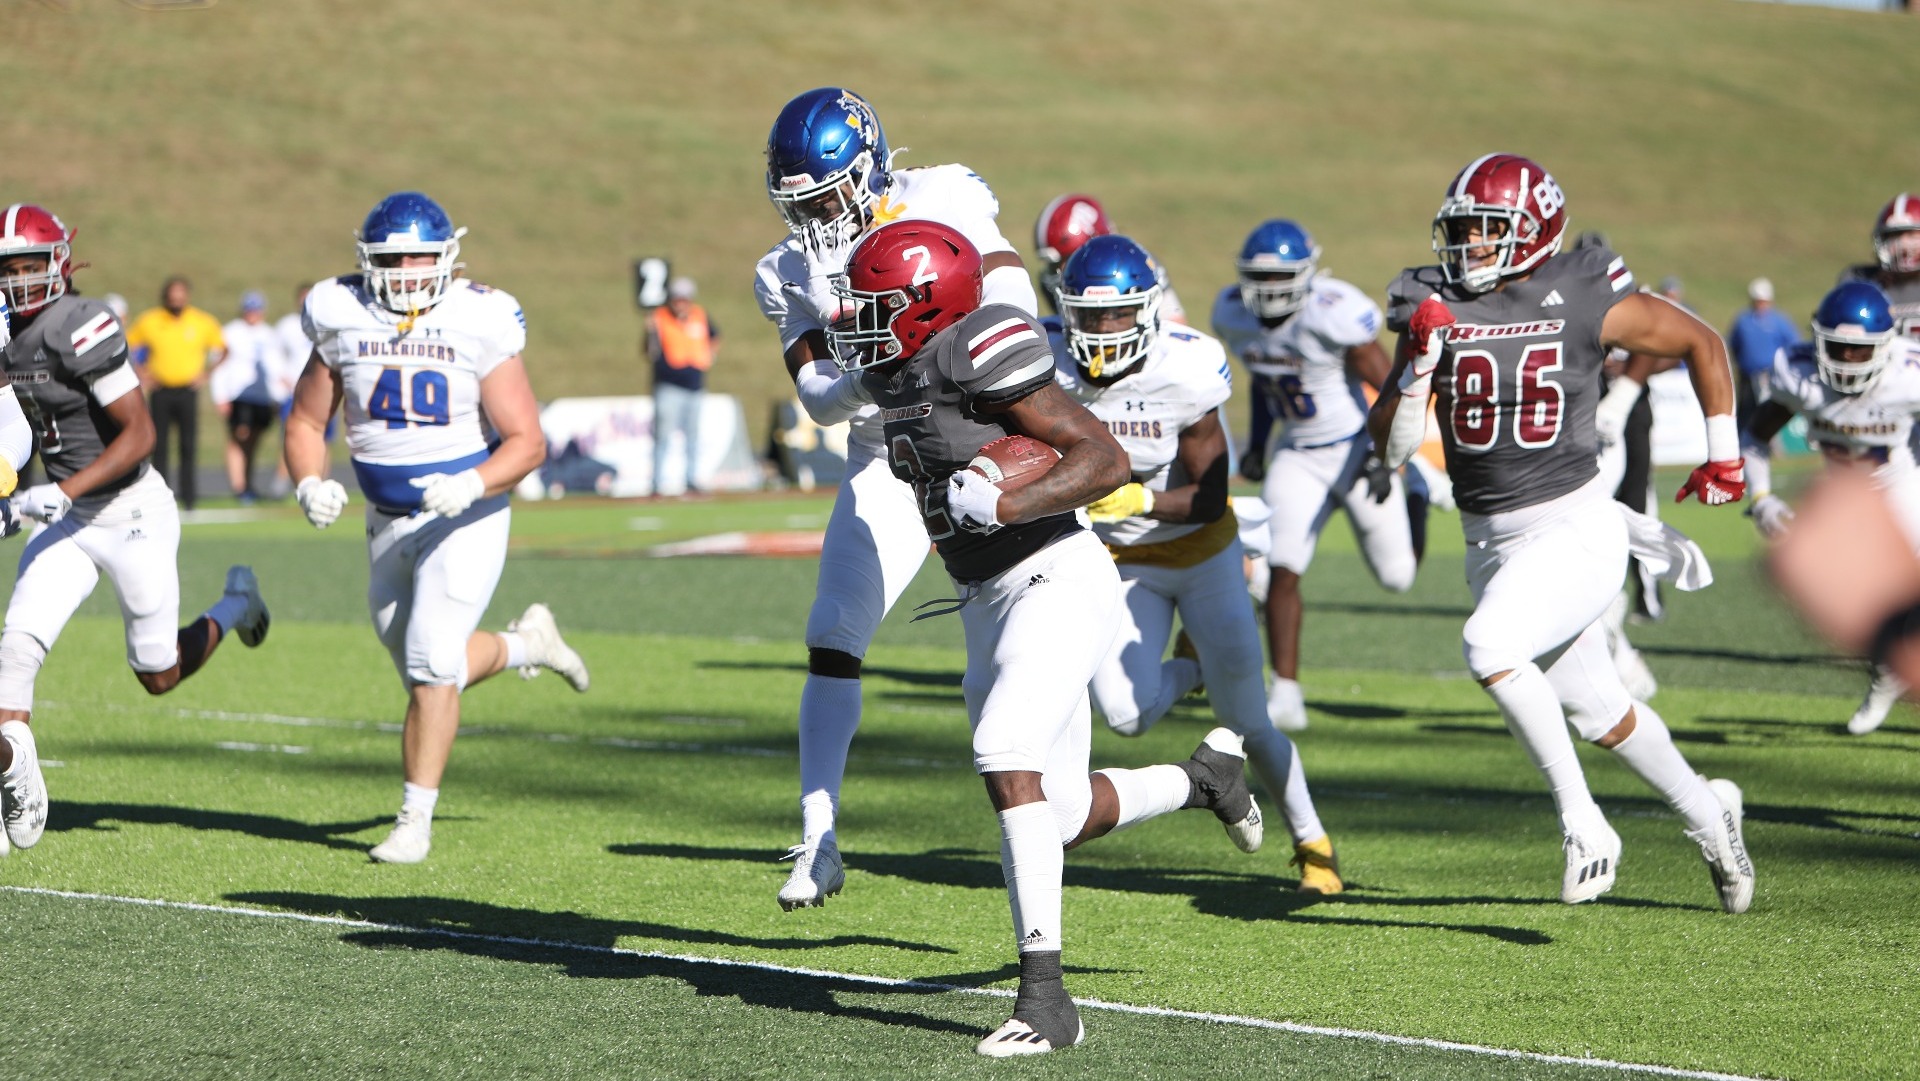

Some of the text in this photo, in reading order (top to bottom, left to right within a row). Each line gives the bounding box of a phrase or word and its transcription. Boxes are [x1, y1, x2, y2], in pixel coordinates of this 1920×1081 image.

[1532, 173, 1566, 220] 86
[639, 258, 668, 307] 2
[902, 245, 939, 287] 2
[358, 341, 455, 363] MULERIDERS
[1445, 319, 1565, 344] REDDIES
[368, 365, 450, 430] 49
[1450, 341, 1565, 451] 86
[1101, 420, 1162, 440] RIDERS
